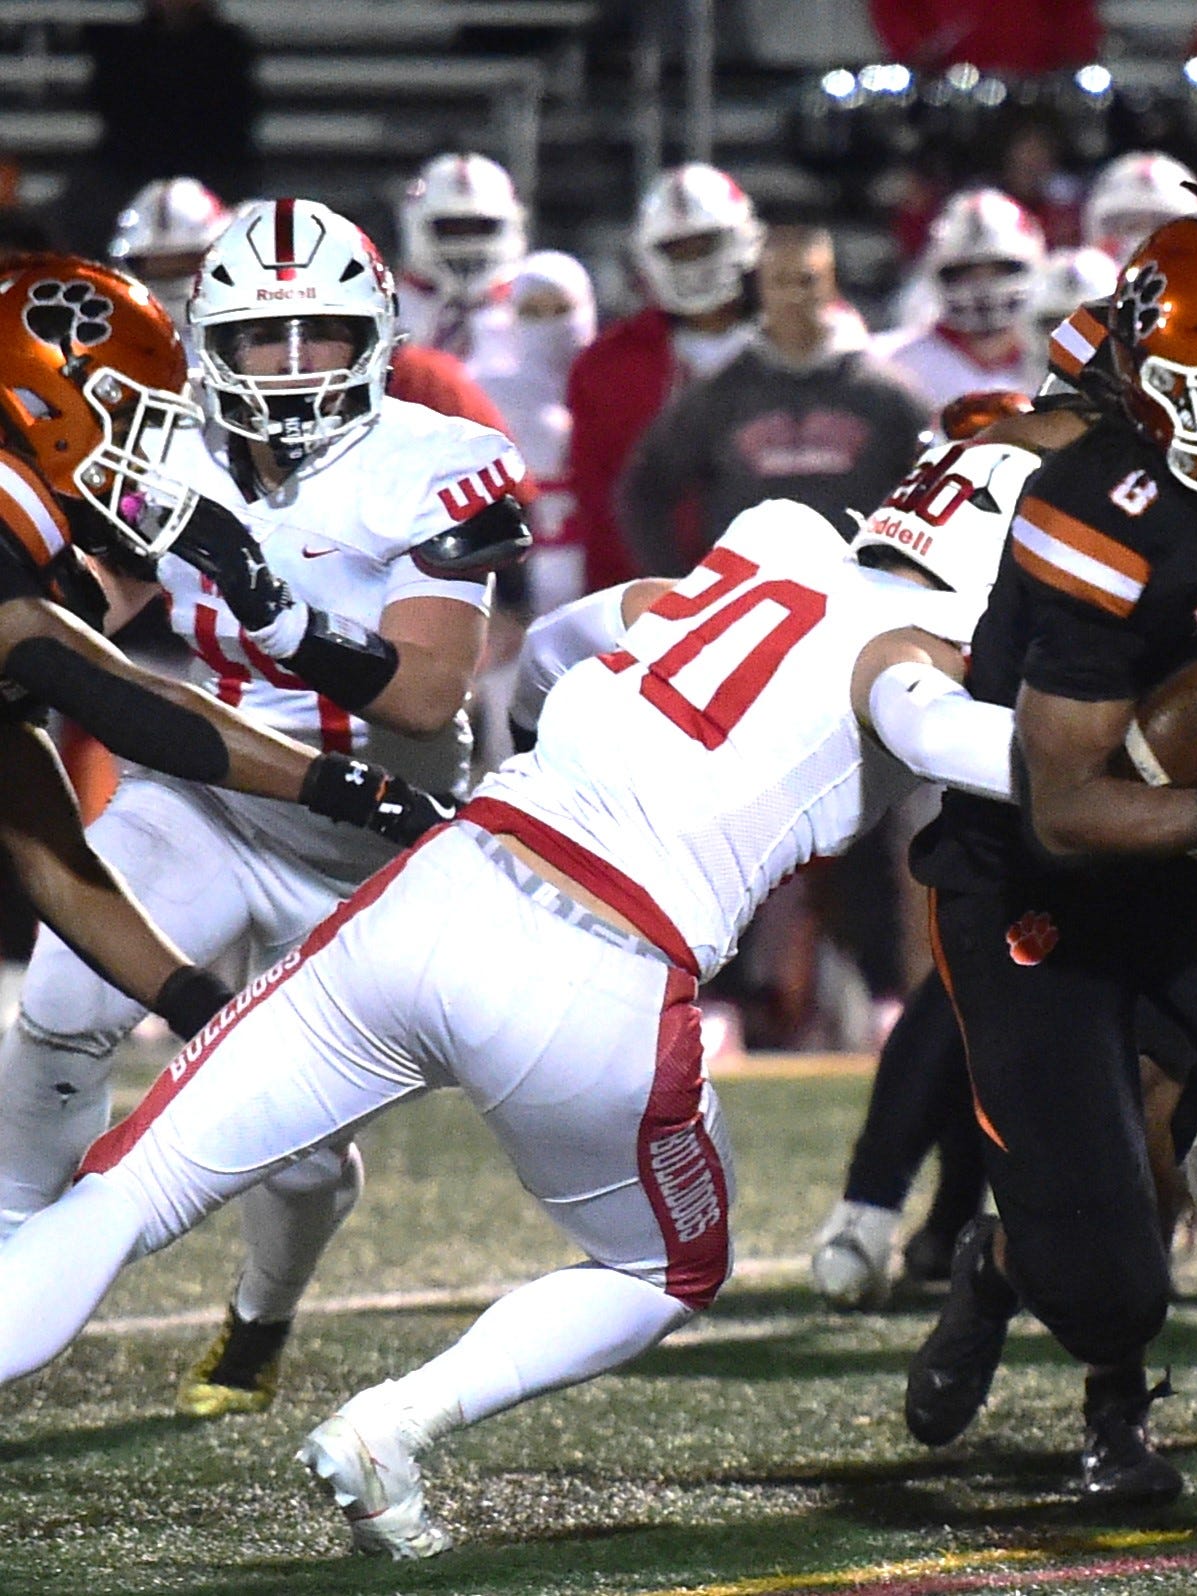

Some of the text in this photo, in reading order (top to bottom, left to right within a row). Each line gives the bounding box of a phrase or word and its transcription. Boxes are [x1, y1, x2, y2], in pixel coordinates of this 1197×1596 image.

[437, 458, 516, 522] 44
[596, 545, 828, 751] 20
[649, 1125, 721, 1243] BULLDOGS
